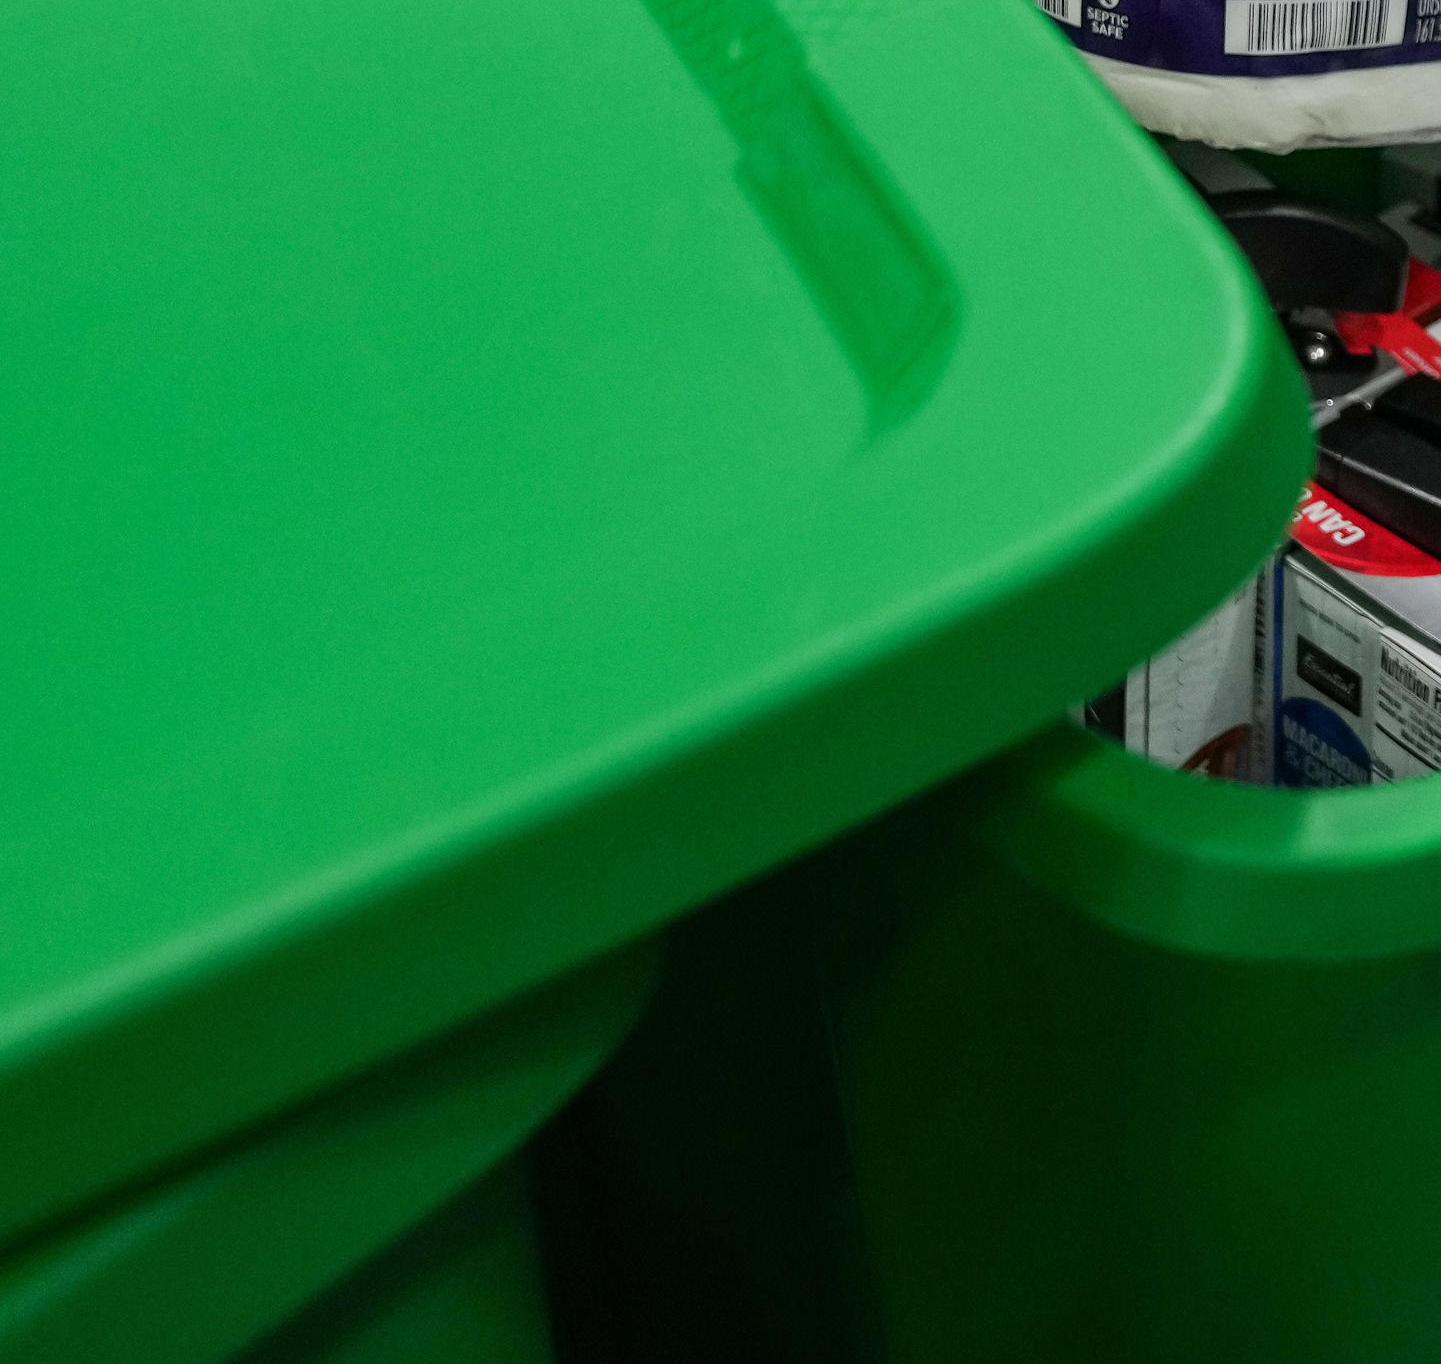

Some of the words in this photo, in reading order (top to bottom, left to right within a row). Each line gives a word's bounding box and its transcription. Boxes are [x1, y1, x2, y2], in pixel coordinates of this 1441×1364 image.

[1087, 6, 1129, 29] SEPTIC
[1092, 21, 1124, 40] SAFE
[1302, 500, 1366, 547] CAN
[1380, 645, 1430, 704] Nutrition
